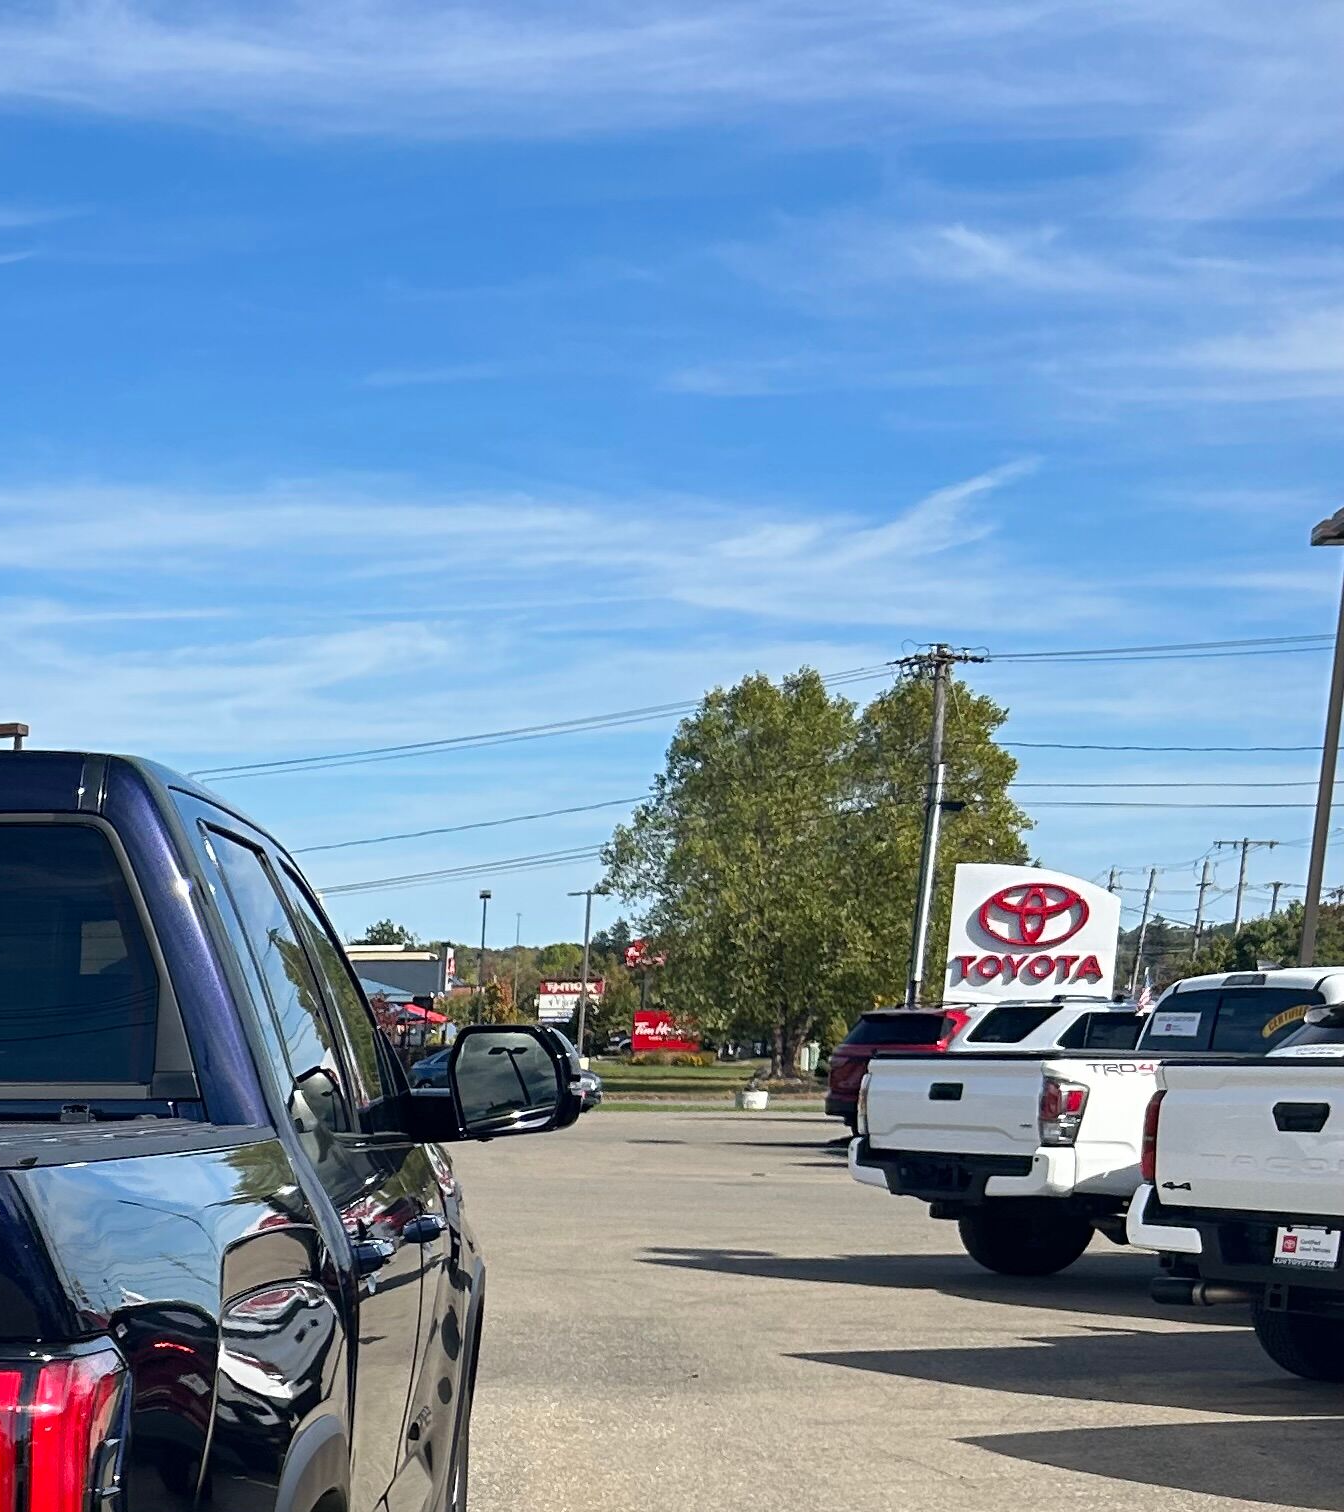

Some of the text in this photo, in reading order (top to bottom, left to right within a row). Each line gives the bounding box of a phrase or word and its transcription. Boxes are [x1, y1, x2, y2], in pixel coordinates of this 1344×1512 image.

[958, 954, 1104, 979] TOYOTA
[1267, 1006, 1308, 1031] CERTIFIE
[1086, 1063, 1137, 1076] TRD
